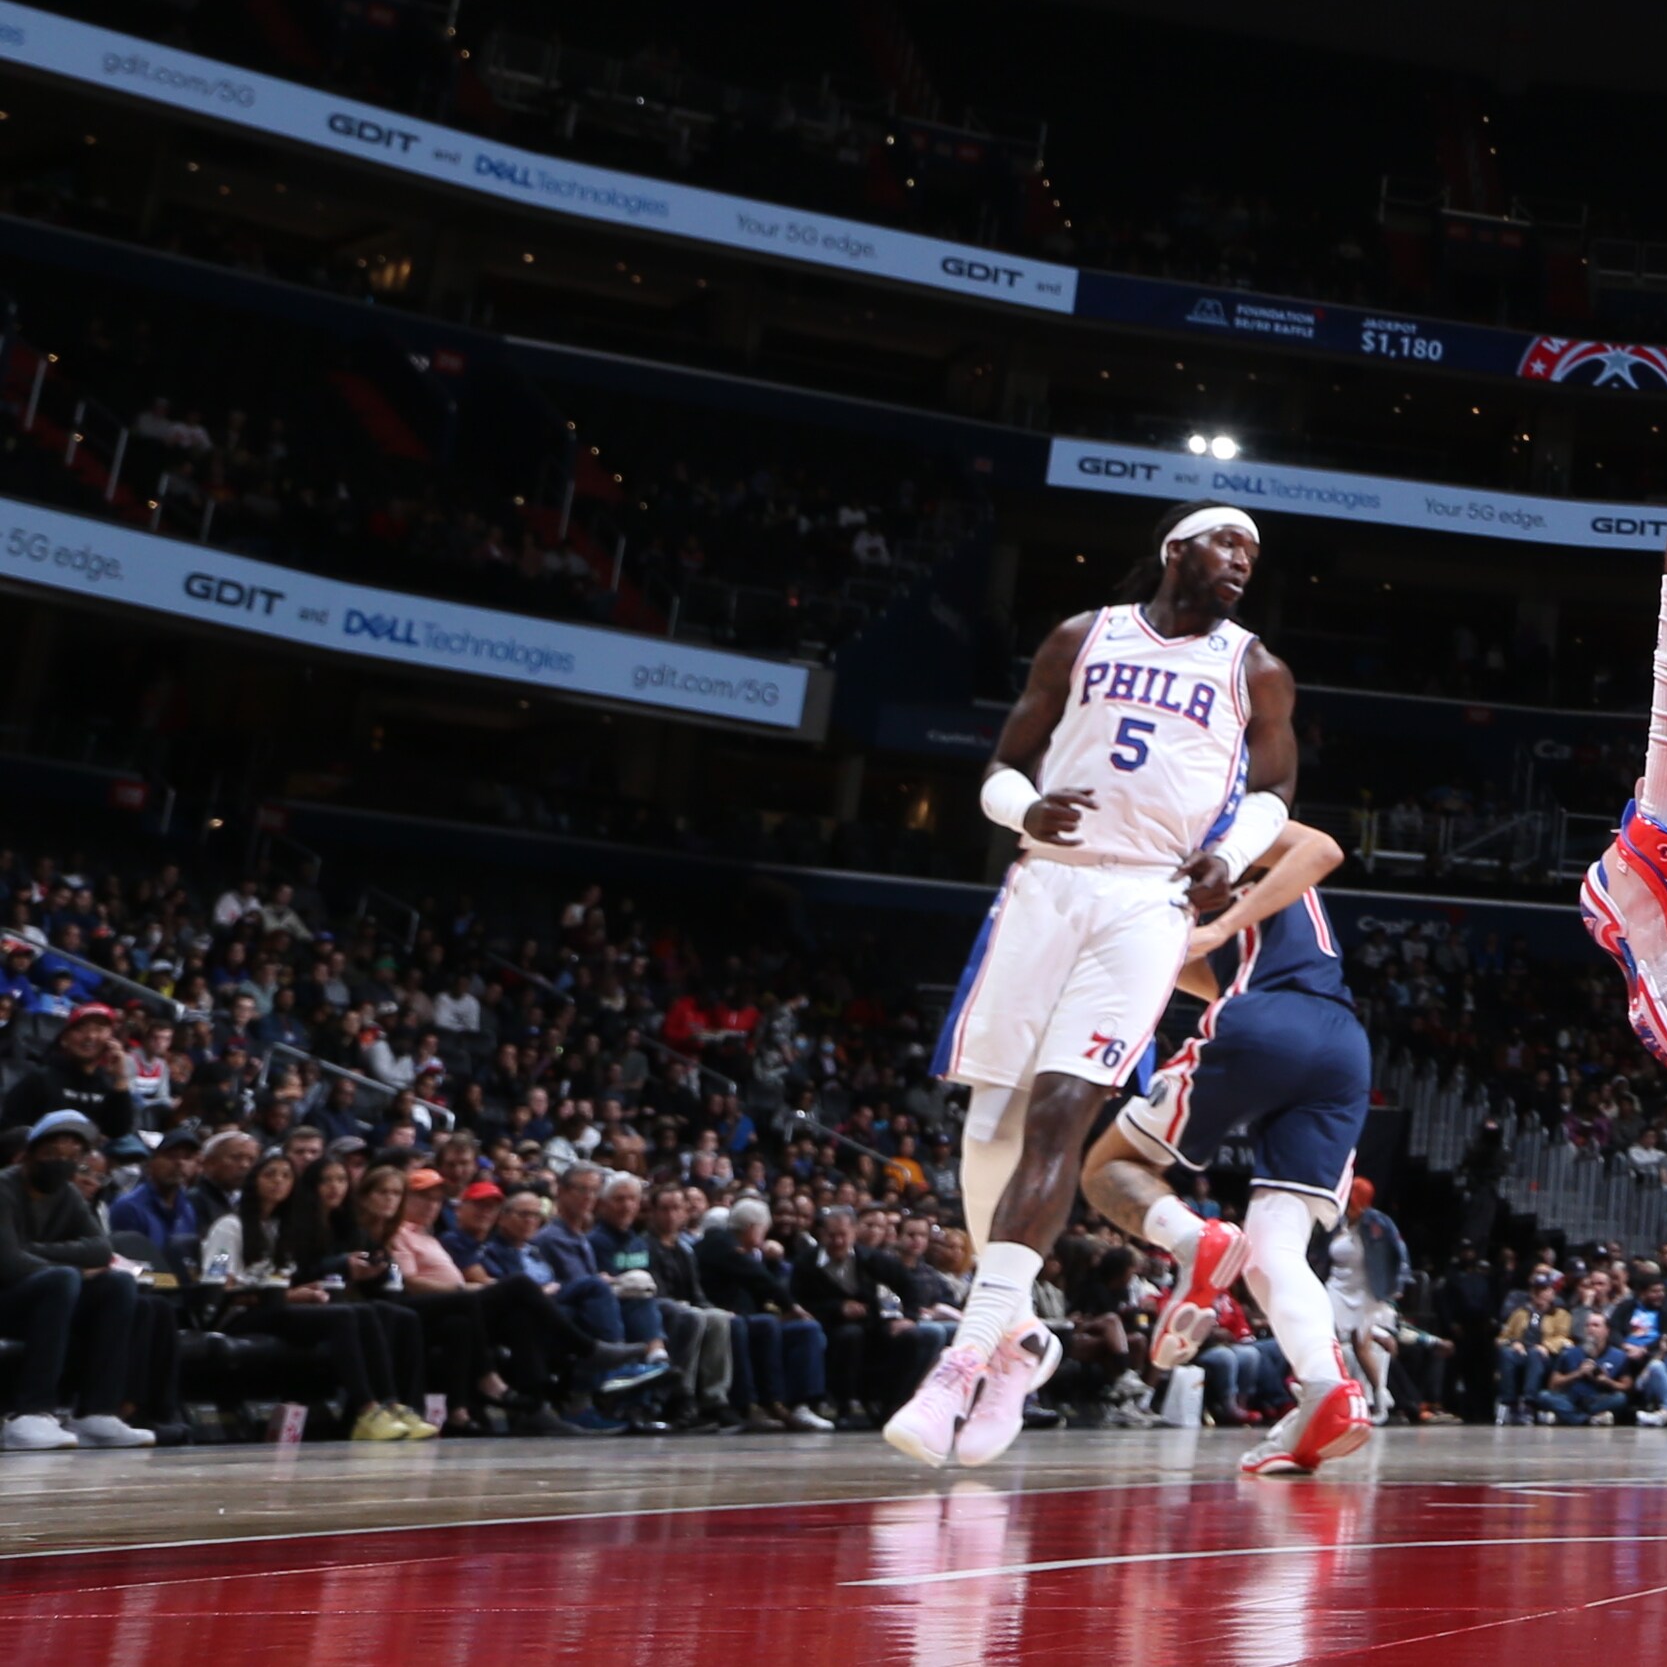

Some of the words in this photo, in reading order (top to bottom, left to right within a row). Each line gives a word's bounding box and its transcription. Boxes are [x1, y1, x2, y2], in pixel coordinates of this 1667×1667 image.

[104, 50, 256, 109] gdit.com/5G
[327, 112, 422, 155] GDIT
[432, 145, 462, 166] and
[474, 153, 536, 191] DELL
[537, 166, 669, 221] Technologies
[735, 213, 780, 240] Your
[786, 224, 818, 247] 5G
[939, 256, 1024, 289] GDIT
[1035, 279, 1062, 297] and
[1361, 316, 1418, 334] JACKPOT
[1361, 332, 1443, 362] $1,180
[1078, 457, 1160, 481] GDIT
[1213, 473, 1266, 496] DELL
[1270, 478, 1381, 509] Technologies
[1424, 498, 1460, 517] Your
[1468, 504, 1495, 522] 5G
[1498, 510, 1547, 531] edge.
[1590, 517, 1667, 537] GDIT
[7, 527, 50, 562] 5G
[53, 542, 124, 584] edge.
[183, 572, 286, 617] GDIT
[298, 604, 330, 627] and
[343, 605, 420, 649] DELL
[422, 621, 575, 675] Technologies
[632, 662, 780, 707] gdit.com/5G
[1080, 661, 1217, 729] PHILA
[1111, 717, 1155, 773] 5
[1083, 1032, 1126, 1069] 76
